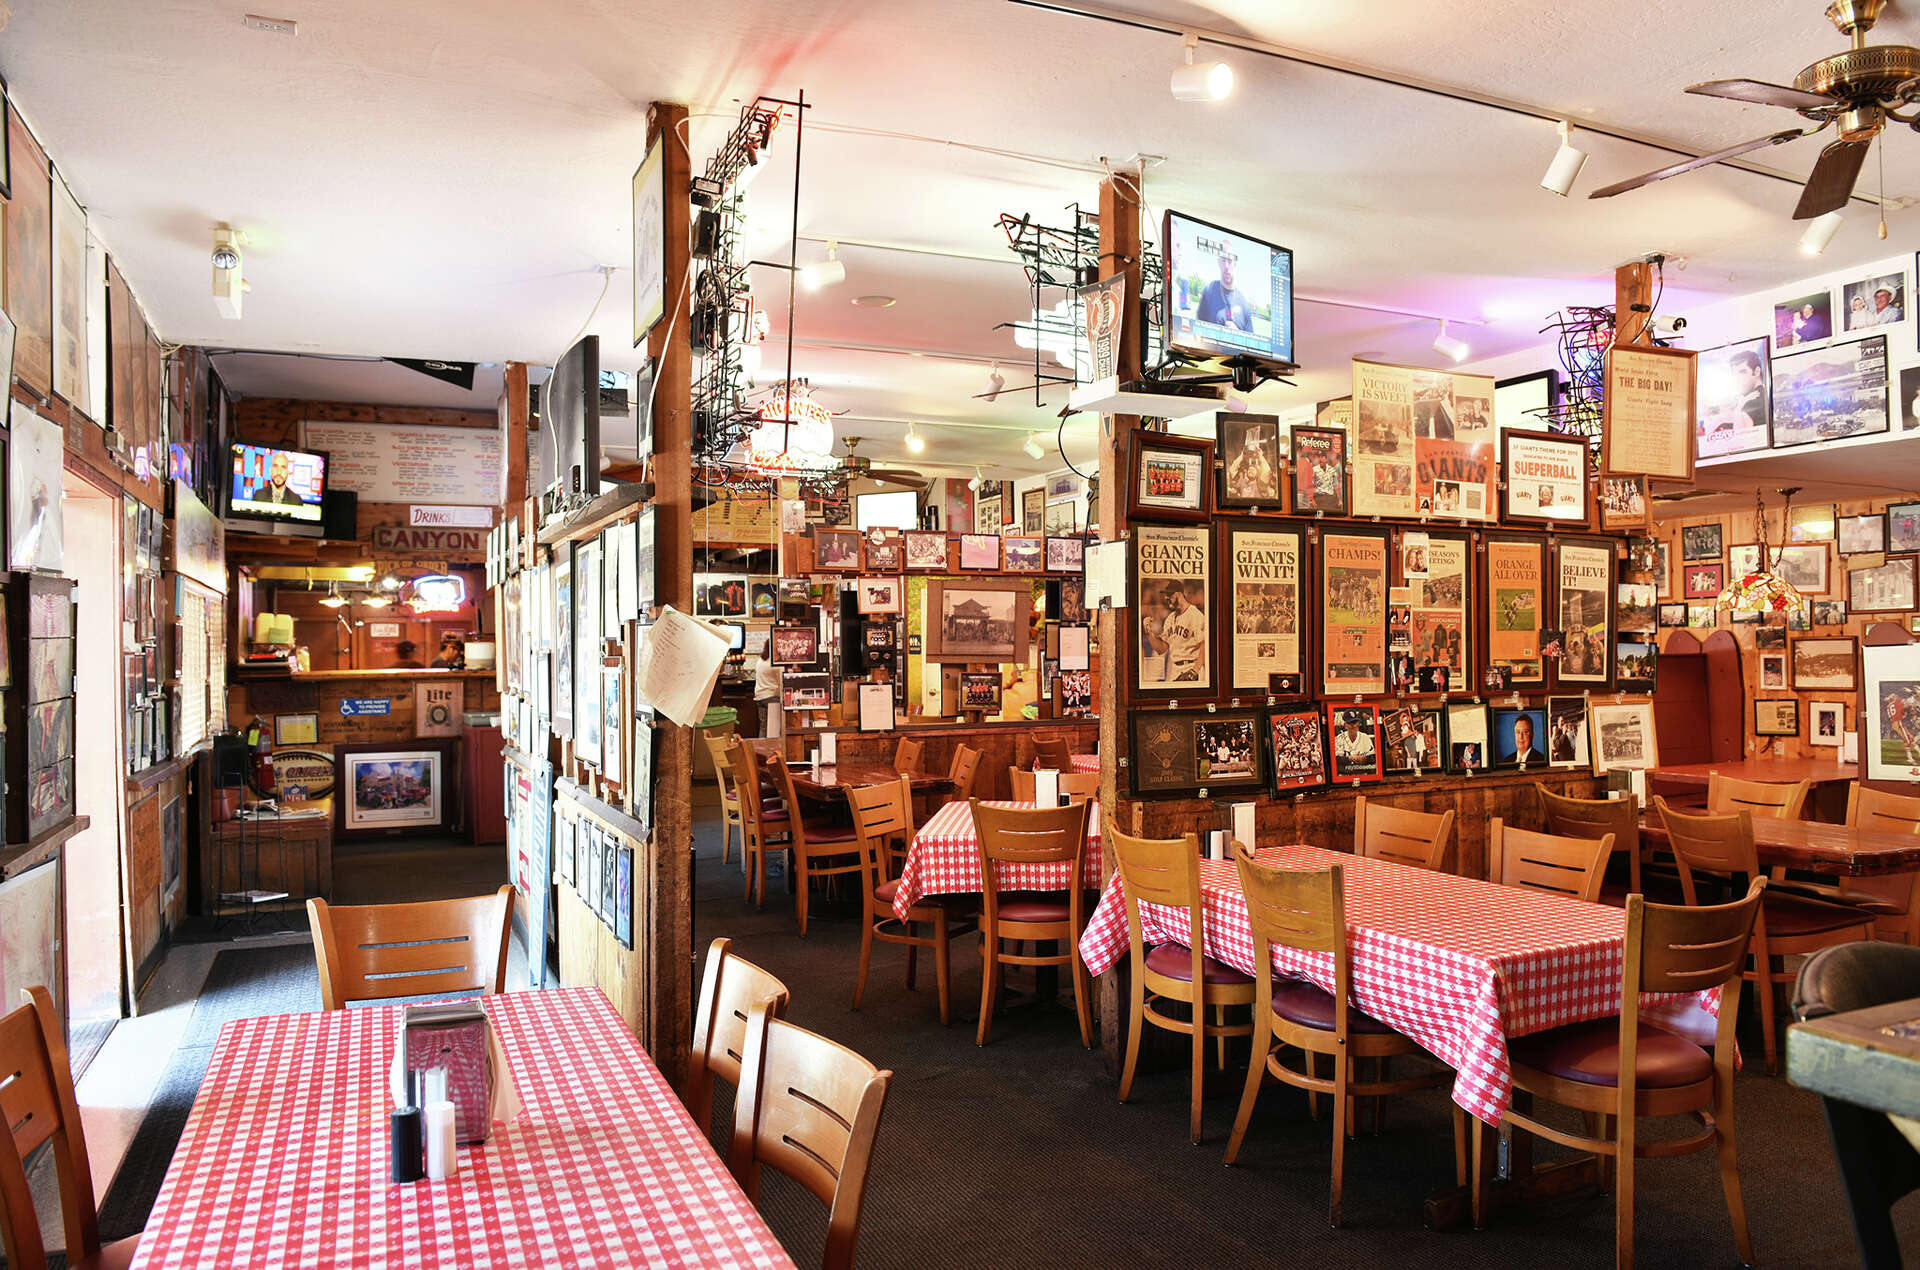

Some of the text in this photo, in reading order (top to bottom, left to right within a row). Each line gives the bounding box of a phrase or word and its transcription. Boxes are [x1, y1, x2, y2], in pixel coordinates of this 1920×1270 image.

[1362, 376, 1408, 393] VICTORY
[1619, 376, 1673, 392] THE BIG DAY!
[1362, 389, 1409, 403] IS SWEET
[1300, 435, 1330, 449] Referee
[1418, 457, 1487, 485] GIANTS
[1514, 460, 1577, 480] SUEPERBALL
[379, 530, 479, 549] CANYON
[1141, 544, 1204, 560] GIANTS
[1236, 550, 1295, 565] GIANTS
[1328, 548, 1381, 561] CHAMPS!
[1141, 560, 1204, 575] CLINCH
[1238, 564, 1295, 578] WIN IT!
[1496, 560, 1535, 570] ORANGE
[1562, 565, 1606, 578] BELIEVE
[1494, 570, 1537, 580] ALL OVER
[1562, 576, 1577, 586] IT!
[426, 690, 452, 703] Lite
